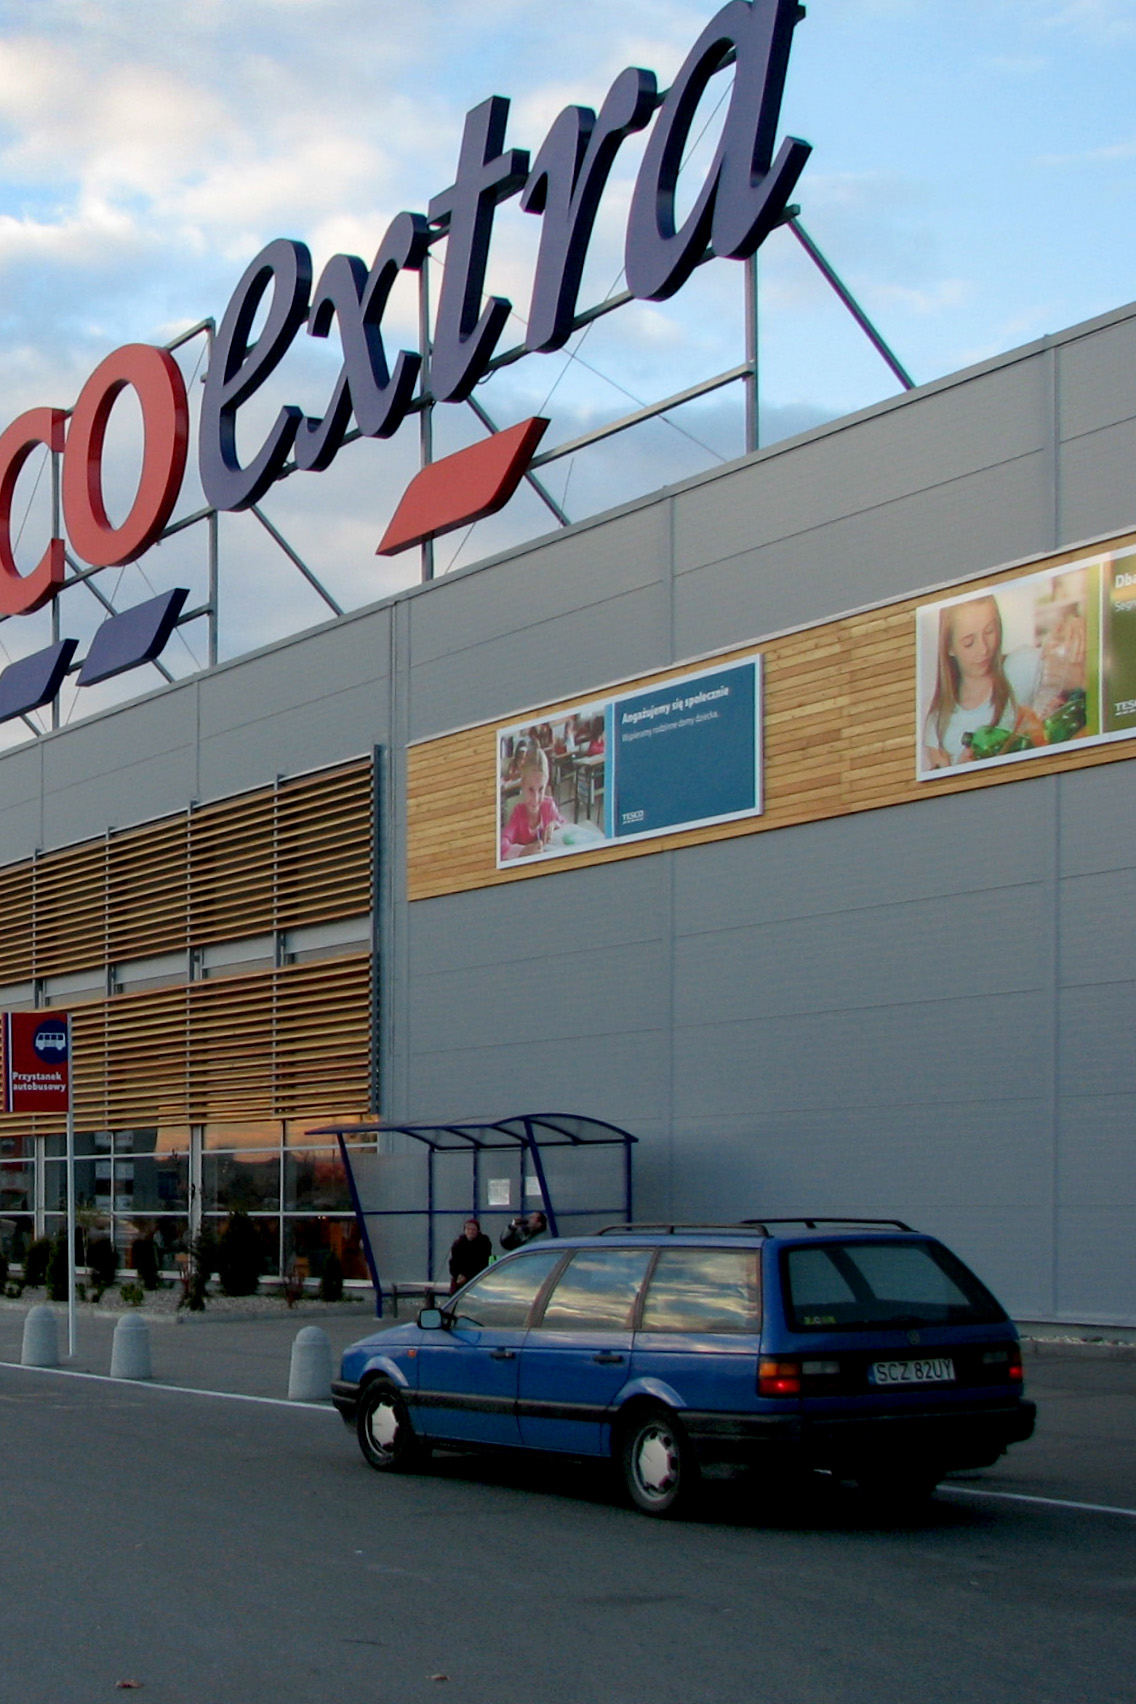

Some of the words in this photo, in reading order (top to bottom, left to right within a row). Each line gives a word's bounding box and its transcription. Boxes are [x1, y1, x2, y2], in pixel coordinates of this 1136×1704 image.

[200, 0, 813, 512] extra
[12, 1071, 62, 1082] Przystanek
[12, 1082, 66, 1092] autobusowy
[876, 1363, 910, 1381] SCZ
[914, 1360, 951, 1379] 82UY
